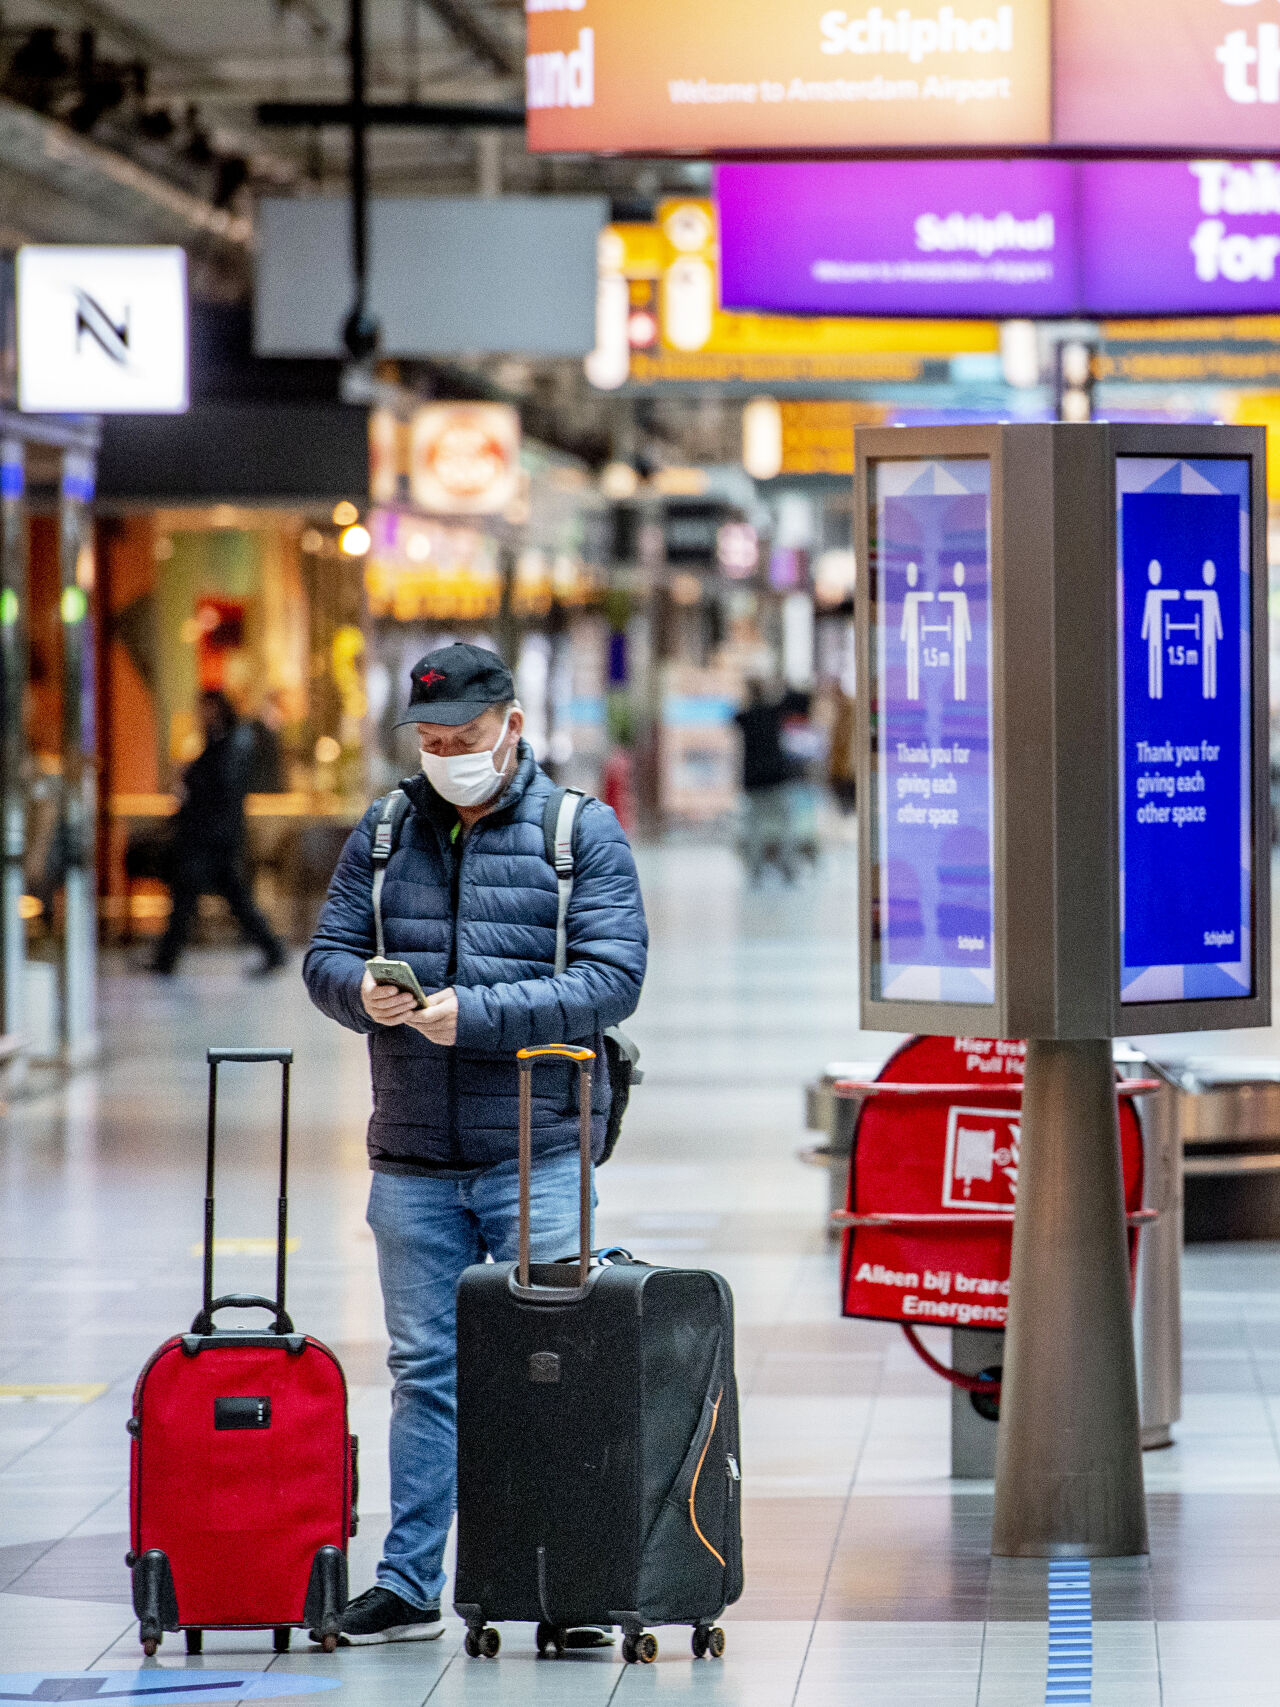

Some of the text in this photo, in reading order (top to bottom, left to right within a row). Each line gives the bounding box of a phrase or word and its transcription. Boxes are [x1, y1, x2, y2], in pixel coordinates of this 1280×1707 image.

[819, 6, 1013, 62] Schiphol
[668, 75, 1011, 104] Welcome to Amsterdam Airport
[896, 742, 971, 769] Thank you for
[1136, 739, 1221, 768] Thank you for
[897, 771, 957, 799] giving each
[1136, 769, 1205, 799] giving each
[897, 802, 959, 829] other space
[1136, 801, 1207, 829] other space
[1203, 929, 1235, 948] Schiphol
[965, 1053, 1003, 1073] Pull
[855, 1262, 919, 1289] Alleen
[923, 1269, 951, 1296] bij
